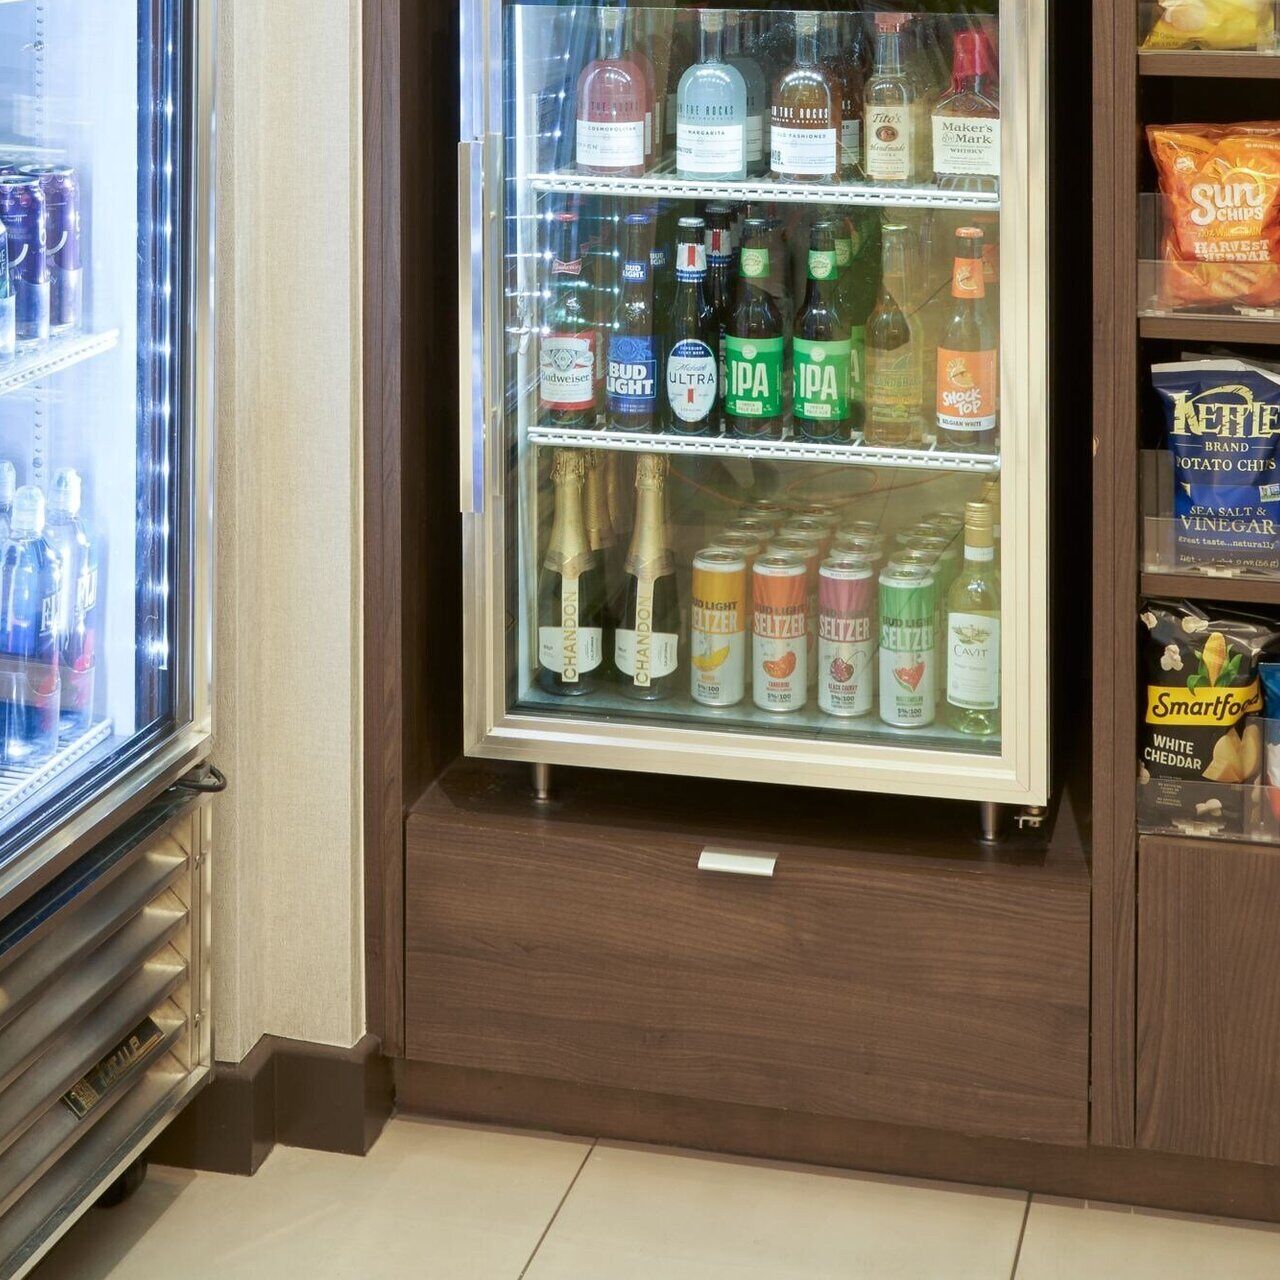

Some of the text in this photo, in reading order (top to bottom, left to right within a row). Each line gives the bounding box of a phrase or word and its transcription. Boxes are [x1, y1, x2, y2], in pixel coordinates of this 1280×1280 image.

[799, 108, 828, 118] ROCKS
[872, 113, 902, 124] Tito's
[942, 122, 994, 133] Maker's
[955, 134, 992, 144] Mark
[1190, 182, 1265, 226] Sun
[1216, 208, 1264, 222] CHIPS
[1194, 239, 1270, 254] HARVEST
[622, 270, 645, 278] LIGHT
[624, 264, 641, 272] BUD
[608, 361, 647, 378] BUD
[669, 372, 715, 385] ULTRA
[731, 360, 769, 398] IPA
[800, 362, 839, 401] IPA
[606, 378, 654, 396] LIGHT
[942, 388, 982, 406] SHOCK
[956, 400, 981, 416] TOP
[964, 419, 982, 427] WHITE
[1205, 441, 1250, 453] BRAND
[1176, 456, 1277, 472] POTATO CHIPS
[1189, 505, 1267, 517] SEA SALT &
[1179, 514, 1277, 535] VINEGAR
[705, 601, 738, 611] LIGHT
[754, 612, 806, 636] SELTZER
[819, 615, 871, 641] SELTZER
[563, 591, 578, 681] CHANDON
[635, 595, 651, 685] CHANDON
[954, 644, 988, 658] CAVIT
[1153, 733, 1195, 755] WHITE
[1144, 746, 1202, 771] CHEDDAR
